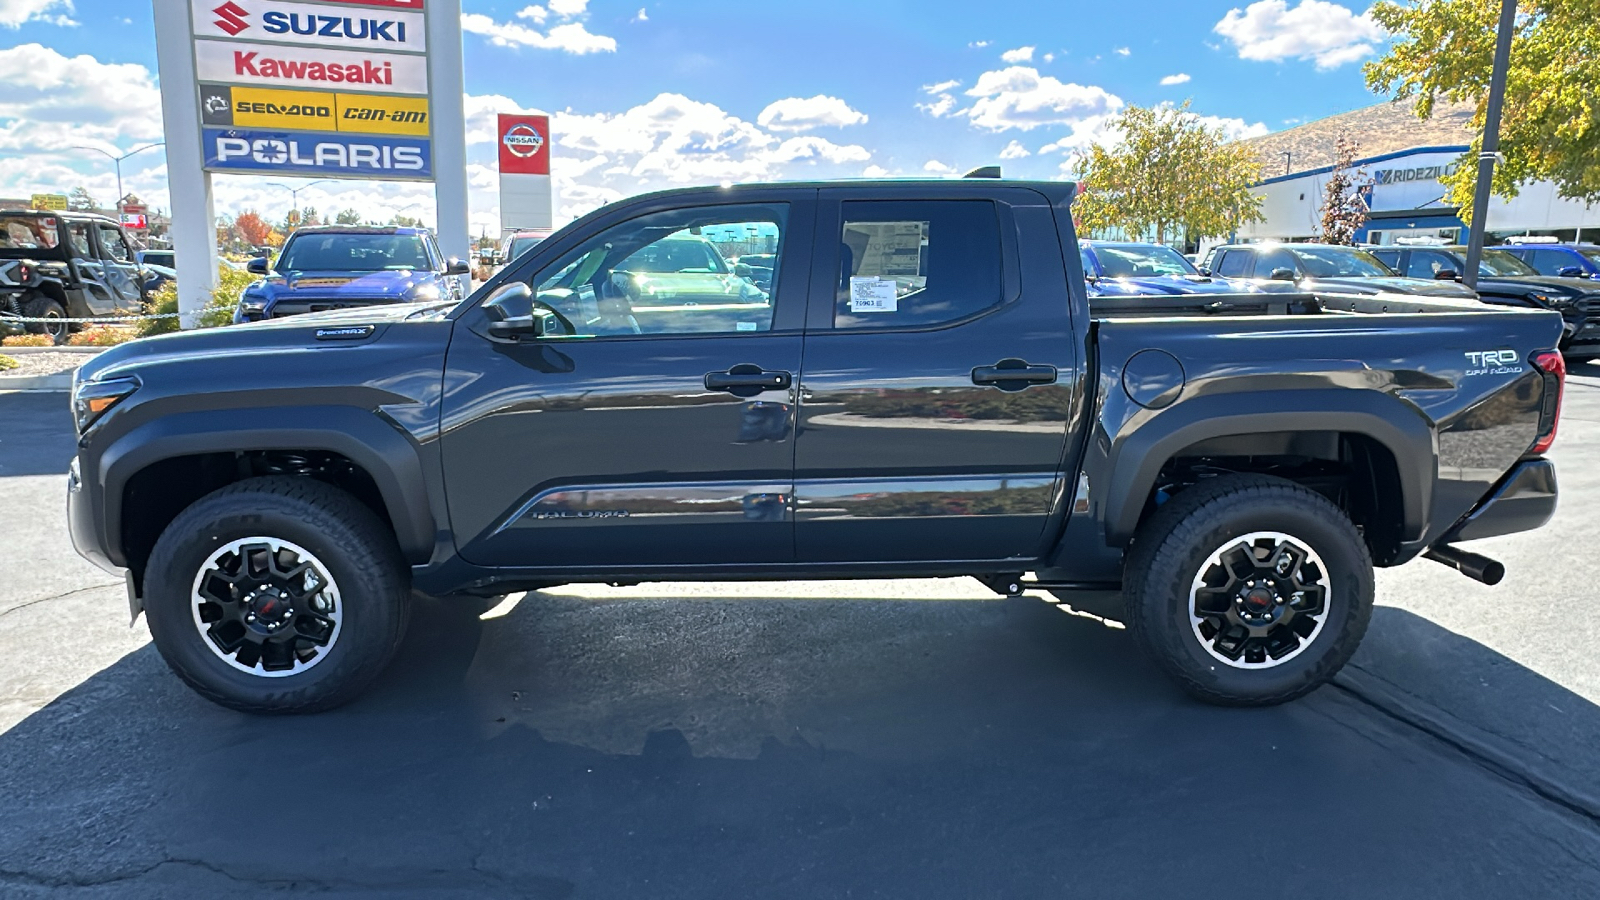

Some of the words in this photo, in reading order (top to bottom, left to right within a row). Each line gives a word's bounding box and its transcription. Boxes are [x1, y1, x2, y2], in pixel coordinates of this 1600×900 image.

[263, 11, 406, 42] SUZUKI
[234, 51, 392, 85] Kawasaki
[216, 137, 424, 170] POLARIS
[1464, 350, 1519, 367] TRD
